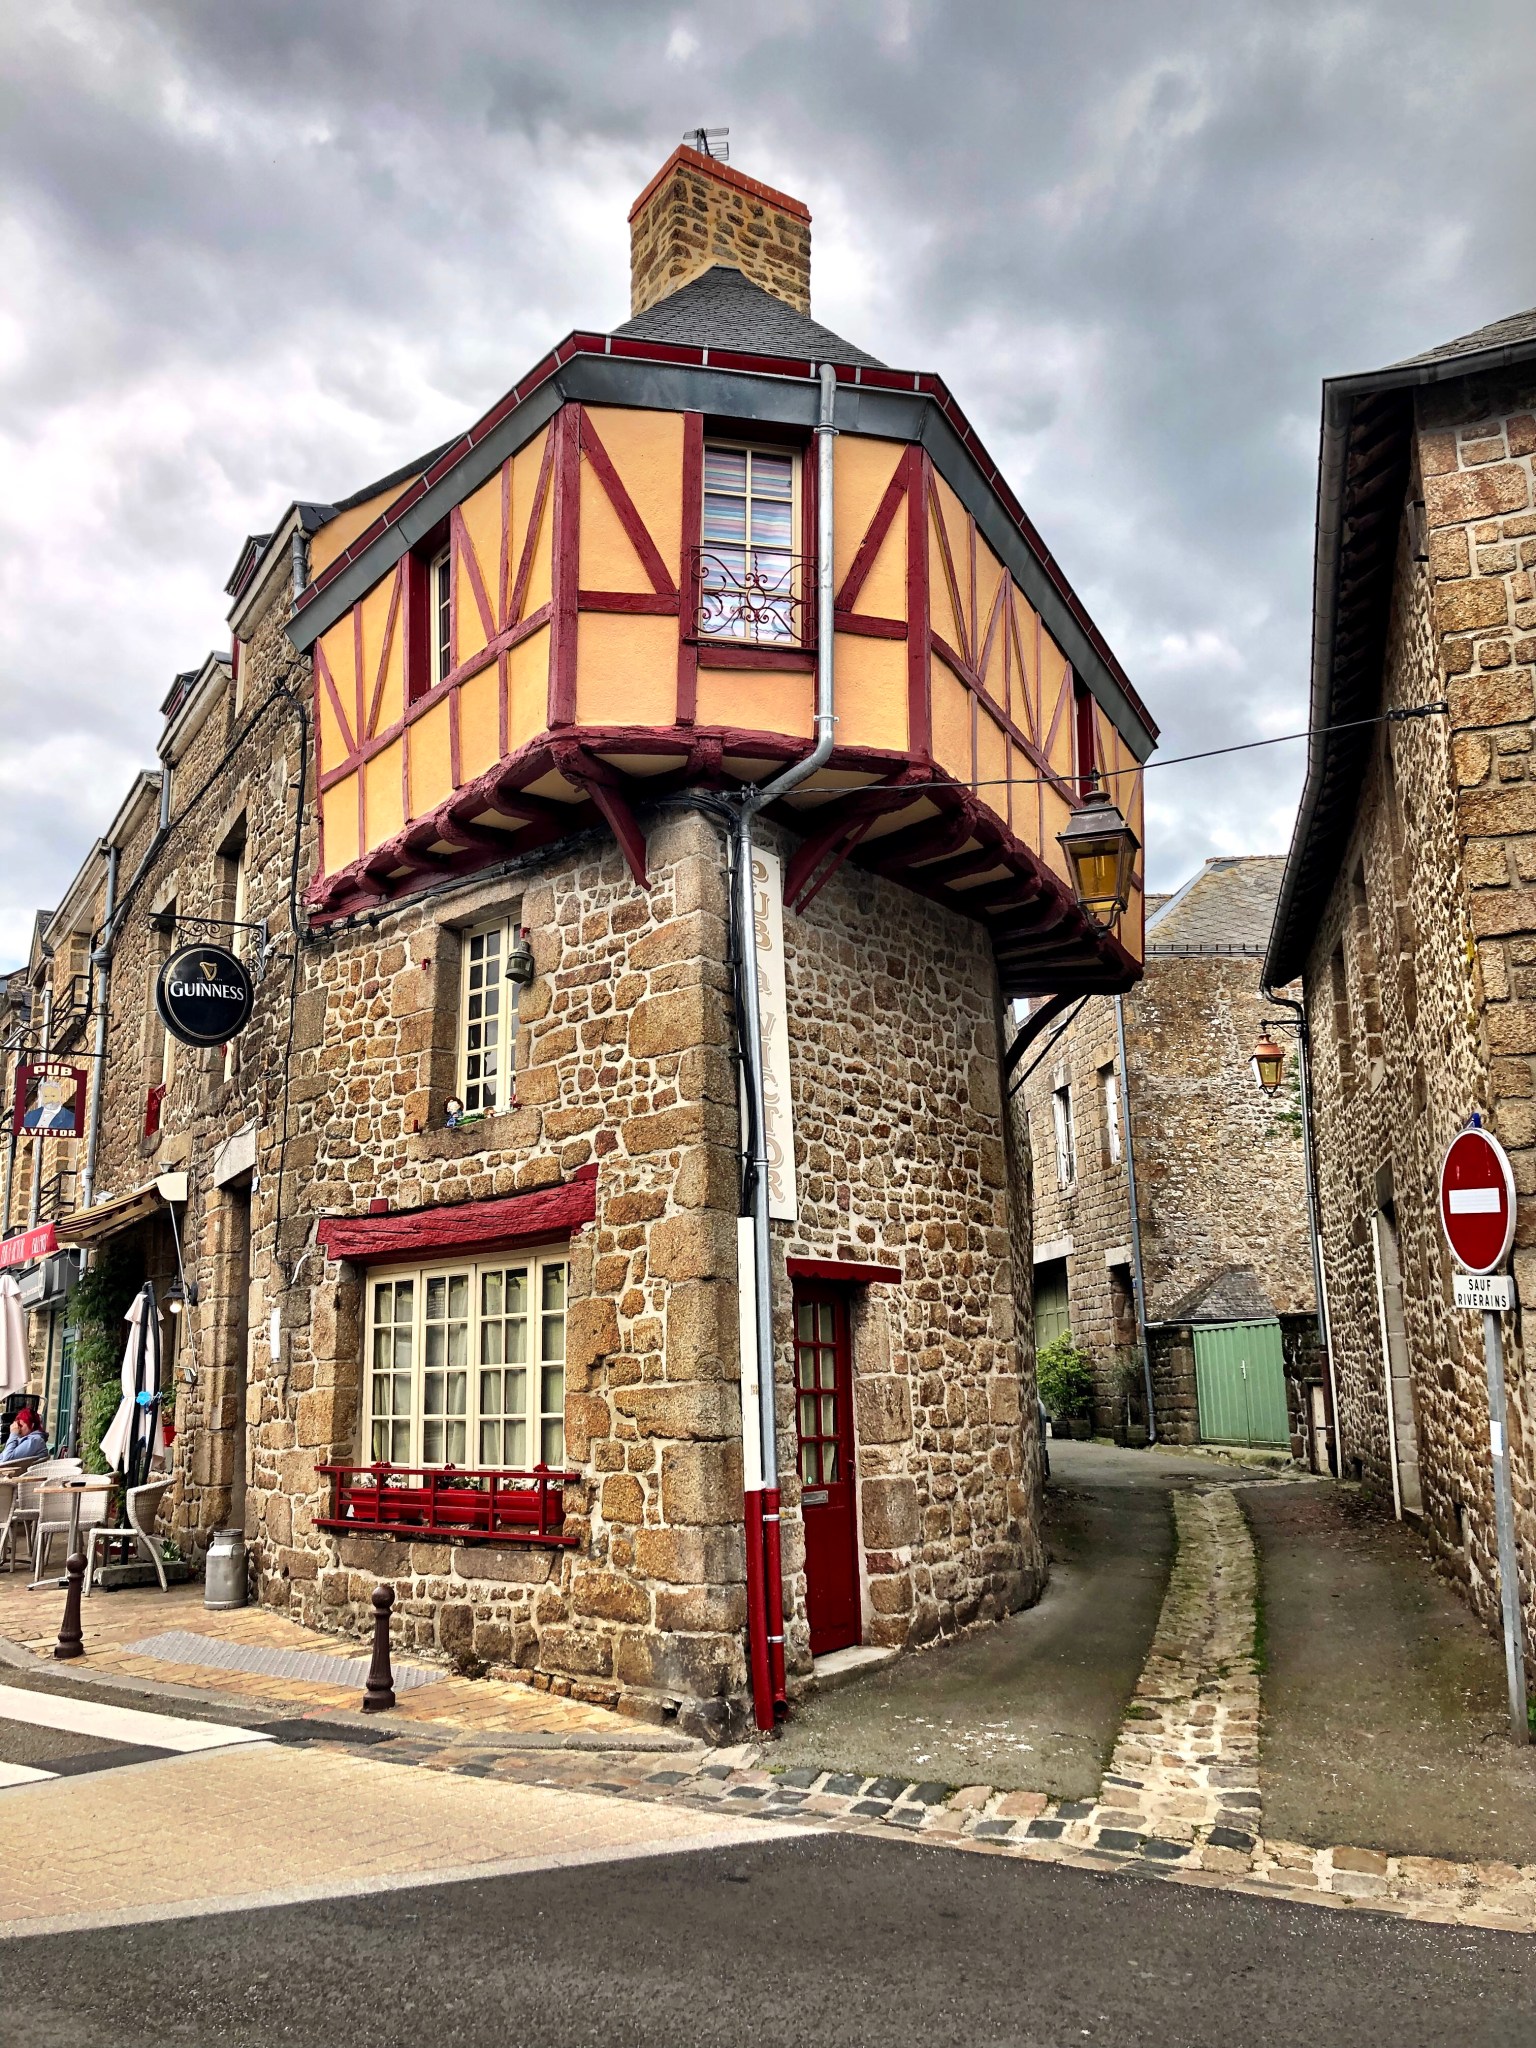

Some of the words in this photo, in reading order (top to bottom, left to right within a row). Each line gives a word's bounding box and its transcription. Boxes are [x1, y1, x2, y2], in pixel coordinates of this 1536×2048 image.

[169, 980, 244, 1000] GUINNESS
[33, 1065, 72, 1076] PUB
[30, 1128, 76, 1136] VICTOR
[1468, 1278, 1491, 1291] SAUF
[1457, 1293, 1507, 1307] RIVERAINS
